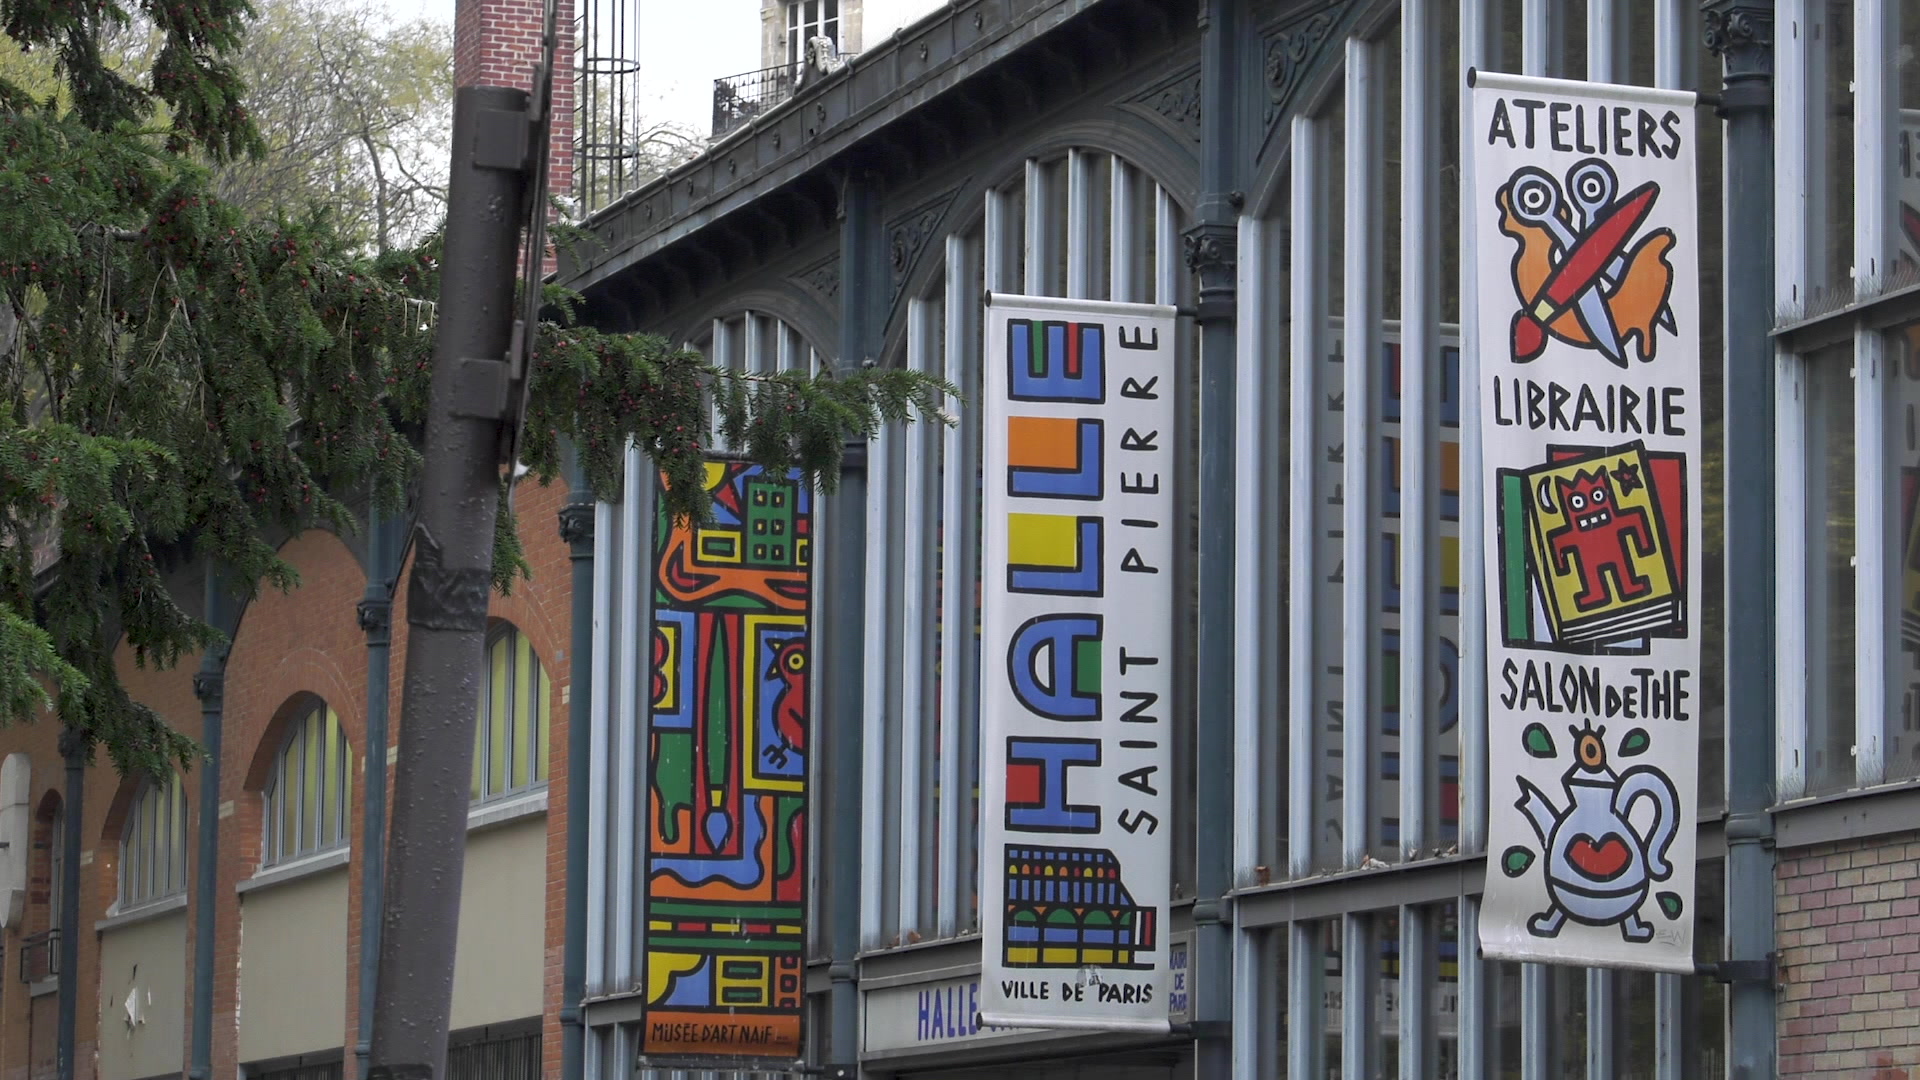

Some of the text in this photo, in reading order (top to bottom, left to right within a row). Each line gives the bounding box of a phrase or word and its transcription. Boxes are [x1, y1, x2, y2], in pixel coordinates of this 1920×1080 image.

[1488, 98, 1681, 160] ATELIERS
[1494, 375, 1686, 436] LIBRAIRIE
[1006, 318, 1105, 834] HALLE
[1117, 326, 1159, 835] SAINT PIERRE
[1500, 657, 1600, 717] SALON
[1001, 980, 1153, 1004] VILLE DE PARIS
[1174, 973, 1185, 990] DE
[702, 1024, 737, 1042] D'ART
[918, 983, 978, 1041] HALLE
